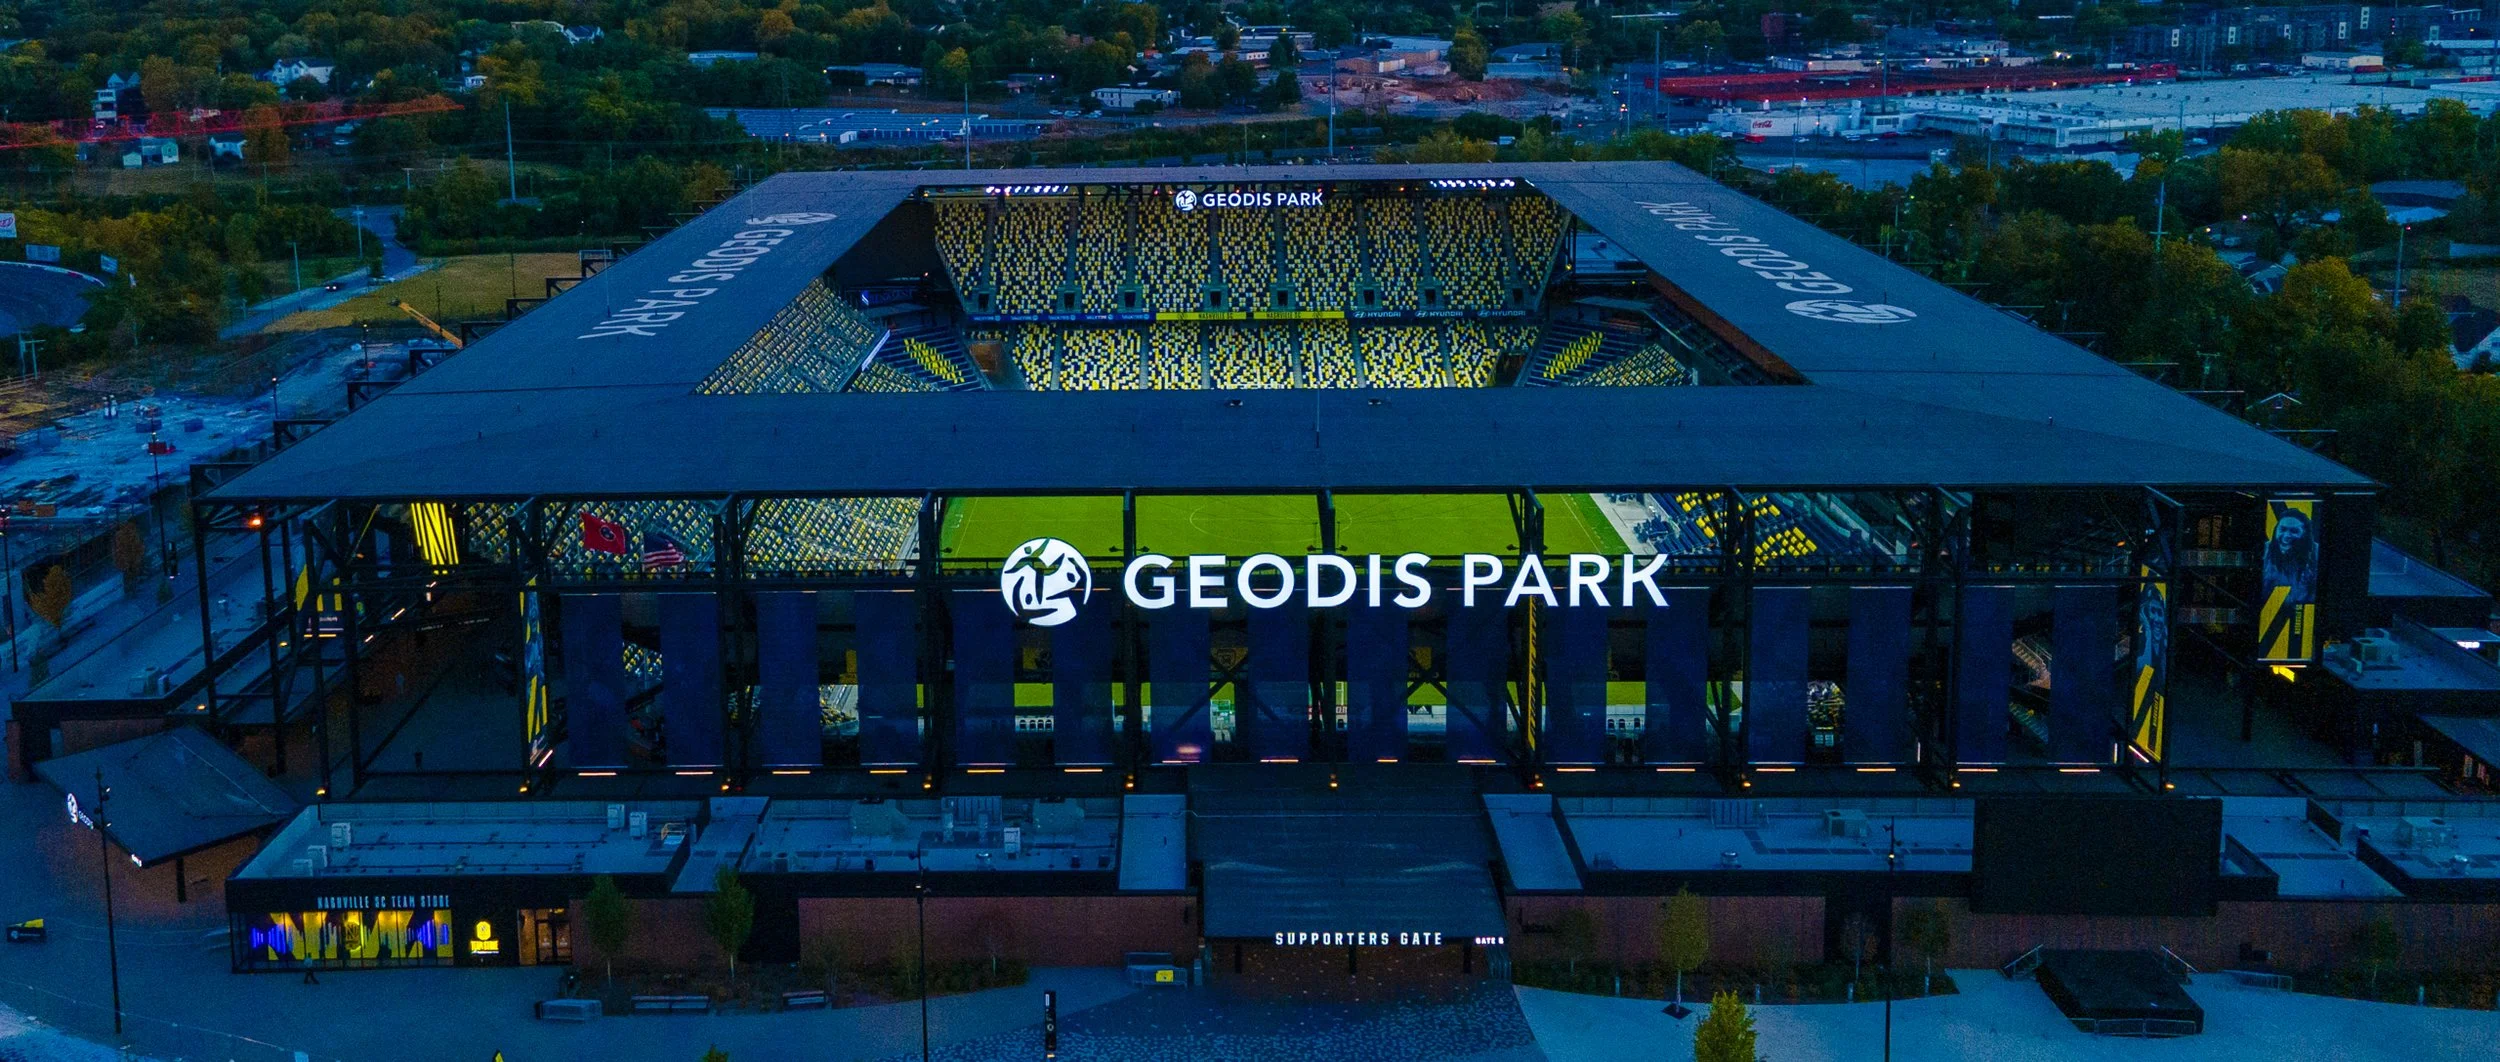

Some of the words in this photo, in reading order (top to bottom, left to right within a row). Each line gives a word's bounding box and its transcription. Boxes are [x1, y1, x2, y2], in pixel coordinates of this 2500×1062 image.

[1203, 192, 1272, 207] GEODIS
[1277, 192, 1323, 206] PARK
[1634, 201, 1740, 231] PARK
[667, 229, 794, 283] GEODIS
[1694, 235, 1854, 294] GEODIS
[577, 287, 719, 340] PARK
[1124, 553, 1431, 609] GEODIS
[1463, 553, 1669, 609] PARK
[317, 896, 369, 909] NASHVILLE
[375, 896, 386, 908] SC
[391, 895, 415, 908] TEAM
[420, 895, 449, 908] STORE
[1275, 932, 1389, 945] SUPPORTERS
[1400, 932, 1442, 945] GATE
[1475, 936, 1496, 945] GATE
